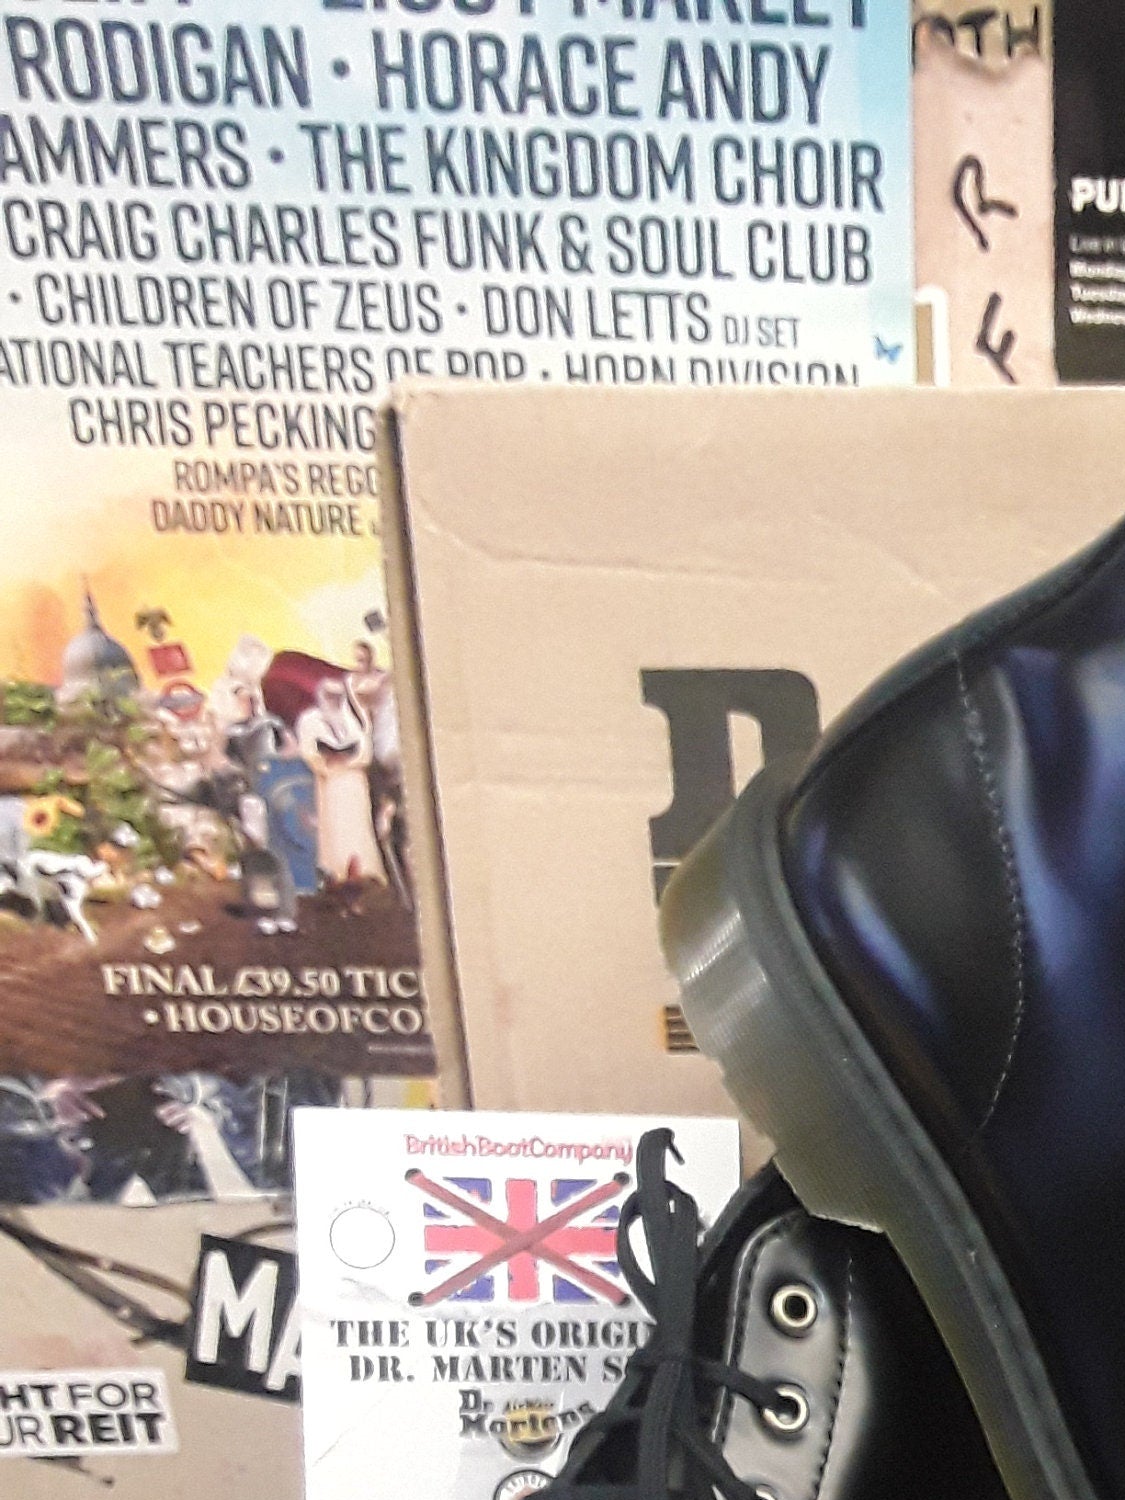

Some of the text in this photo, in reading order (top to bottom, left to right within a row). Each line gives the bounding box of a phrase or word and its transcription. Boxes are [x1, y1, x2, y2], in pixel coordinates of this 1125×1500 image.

[4, 15, 833, 126] RODIGAN HORACE ANDY
[299, 122, 412, 195] THE
[423, 124, 695, 204] KINGDOM
[712, 133, 885, 213] CHOIR
[4, 198, 875, 285] CRAIG CHARLES FUNK & SOUL CLUB
[35, 272, 801, 349] CHILDREN OF ZEUS DON LETTS DJ SET
[162, 341, 375, 394] TEACHERS
[69, 397, 195, 448] CHRIS
[174, 458, 300, 496] ROMPA'S
[150, 499, 362, 537] DADDY NATURE
[102, 963, 228, 998] FINAL
[344, 966, 421, 999] TIC
[331, 1319, 640, 1350] THE UK'S ORIGI
[350, 1355, 416, 1384] DR.
[431, 1354, 588, 1385] MARTEN
[67, 1382, 160, 1412] FOR
